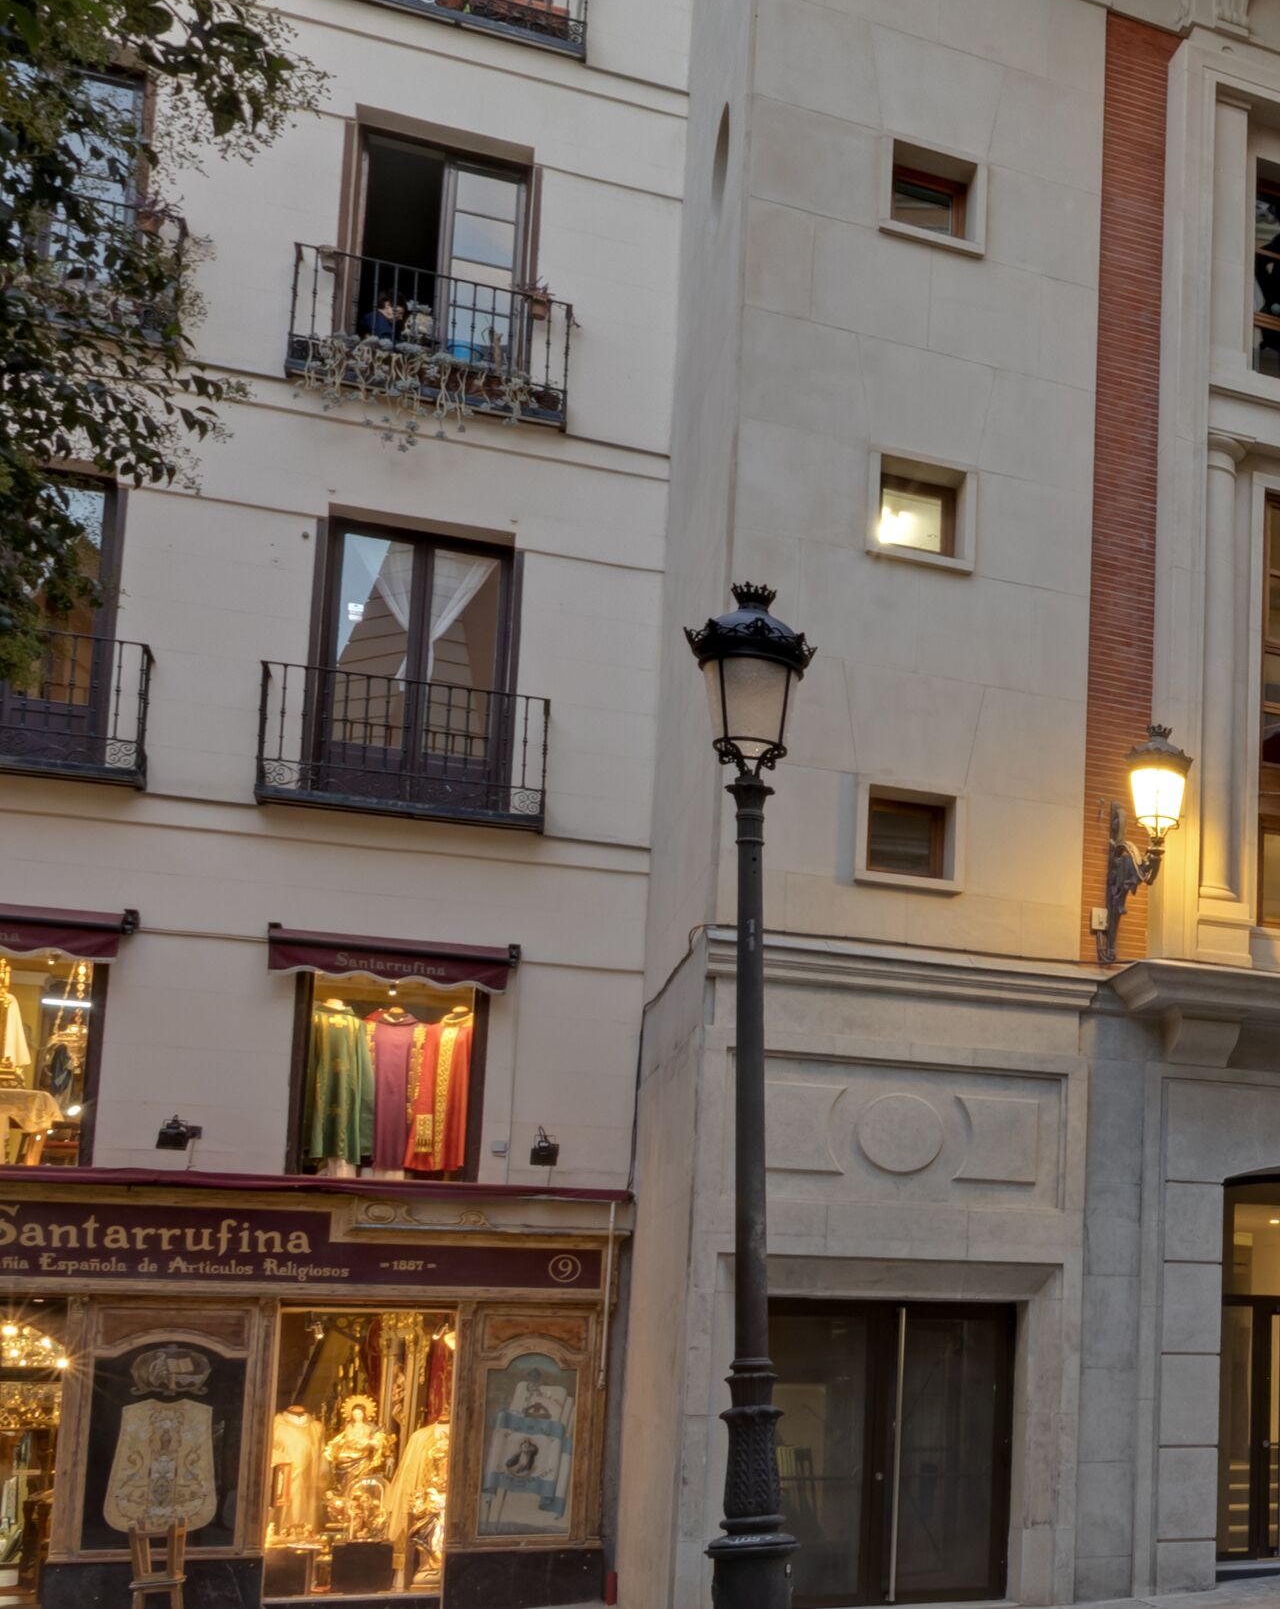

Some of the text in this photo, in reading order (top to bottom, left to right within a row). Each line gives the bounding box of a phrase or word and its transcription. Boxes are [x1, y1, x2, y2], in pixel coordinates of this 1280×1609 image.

[335, 951, 448, 976] Santarrufina
[0, 1204, 312, 1256] Santarrufina
[39, 1252, 127, 1275] Española
[137, 1258, 158, 1272] de
[263, 1258, 350, 1281] Religiosos
[392, 1260, 425, 1271] 1887
[558, 1259, 572, 1278] 9
